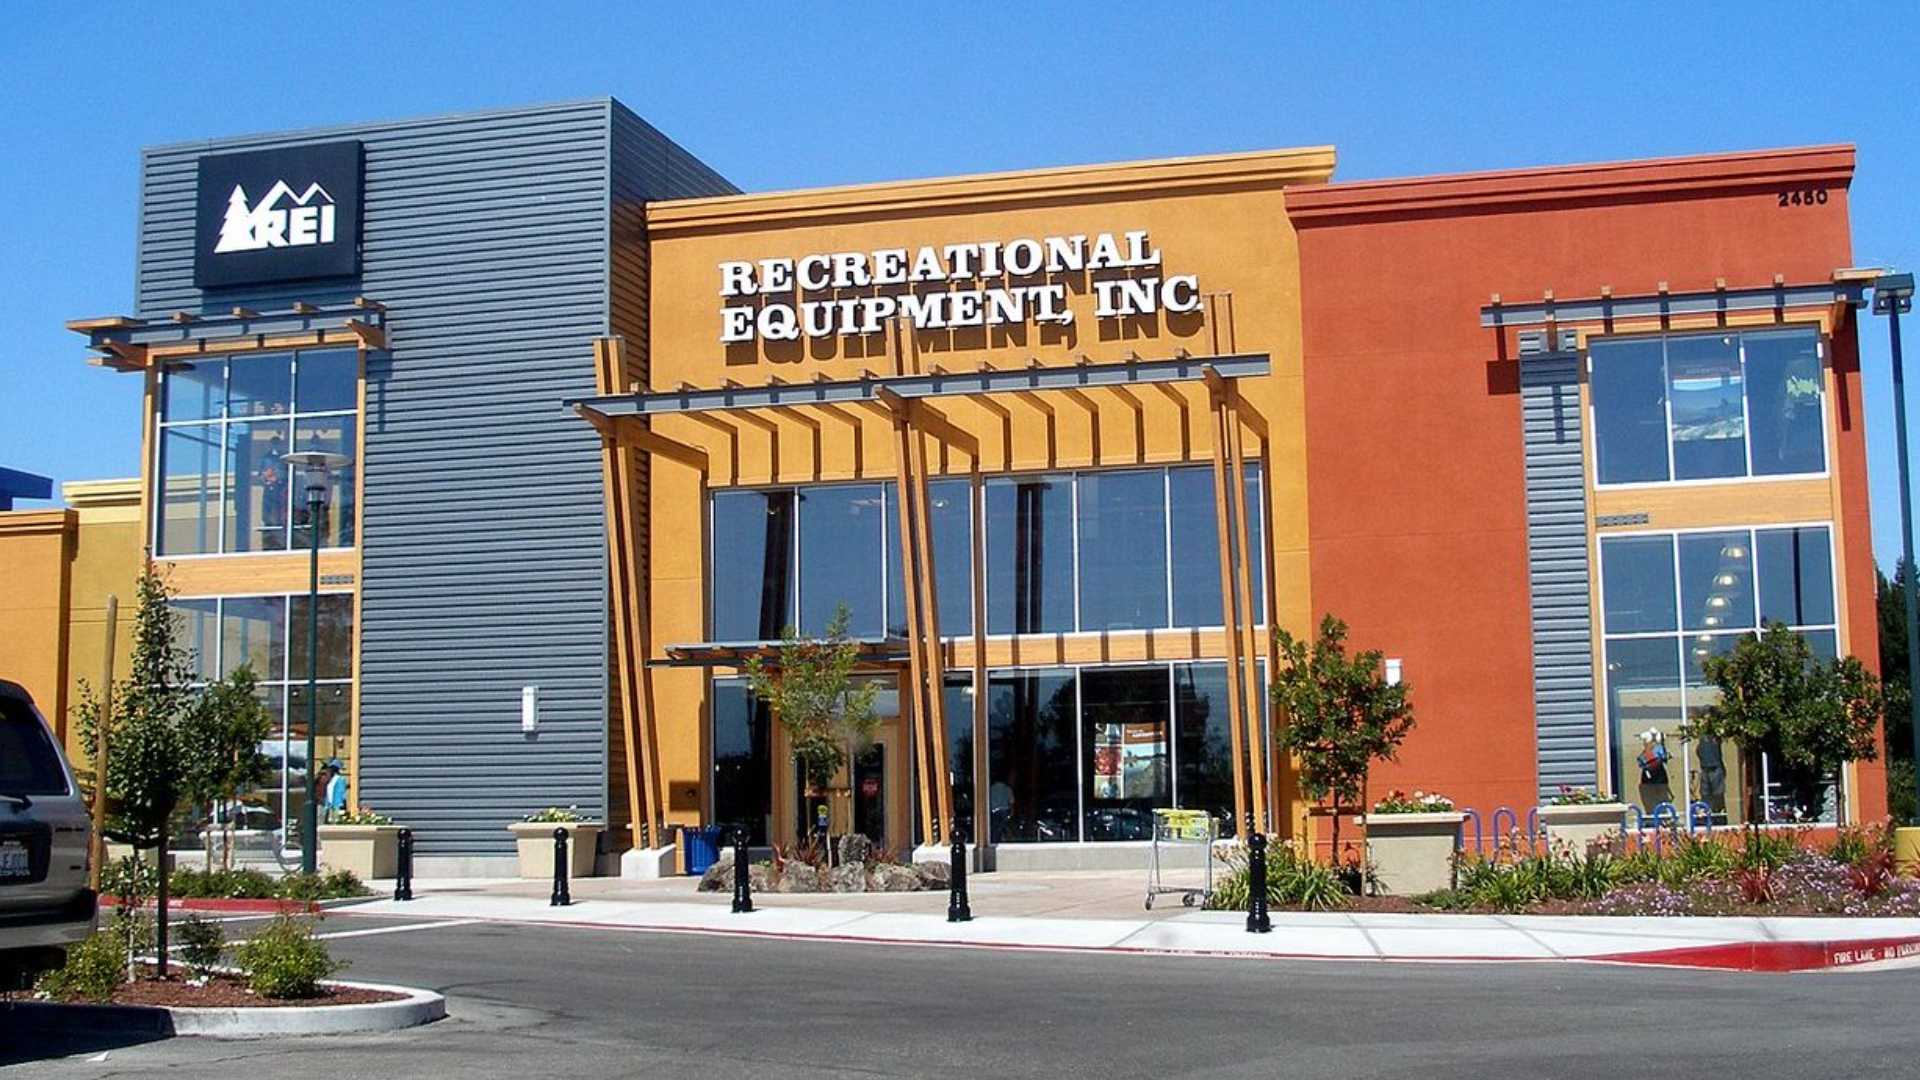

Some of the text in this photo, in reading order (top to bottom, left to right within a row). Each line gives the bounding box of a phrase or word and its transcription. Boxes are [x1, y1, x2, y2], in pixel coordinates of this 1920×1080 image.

[254, 204, 336, 248] REI
[717, 230, 1161, 297] RECREATIONAL
[719, 284, 1074, 343] EQUIPMENT,
[1834, 951, 1853, 964] FIRE
[1855, 948, 1876, 962] LANE
[1884, 946, 1895, 958] NO
